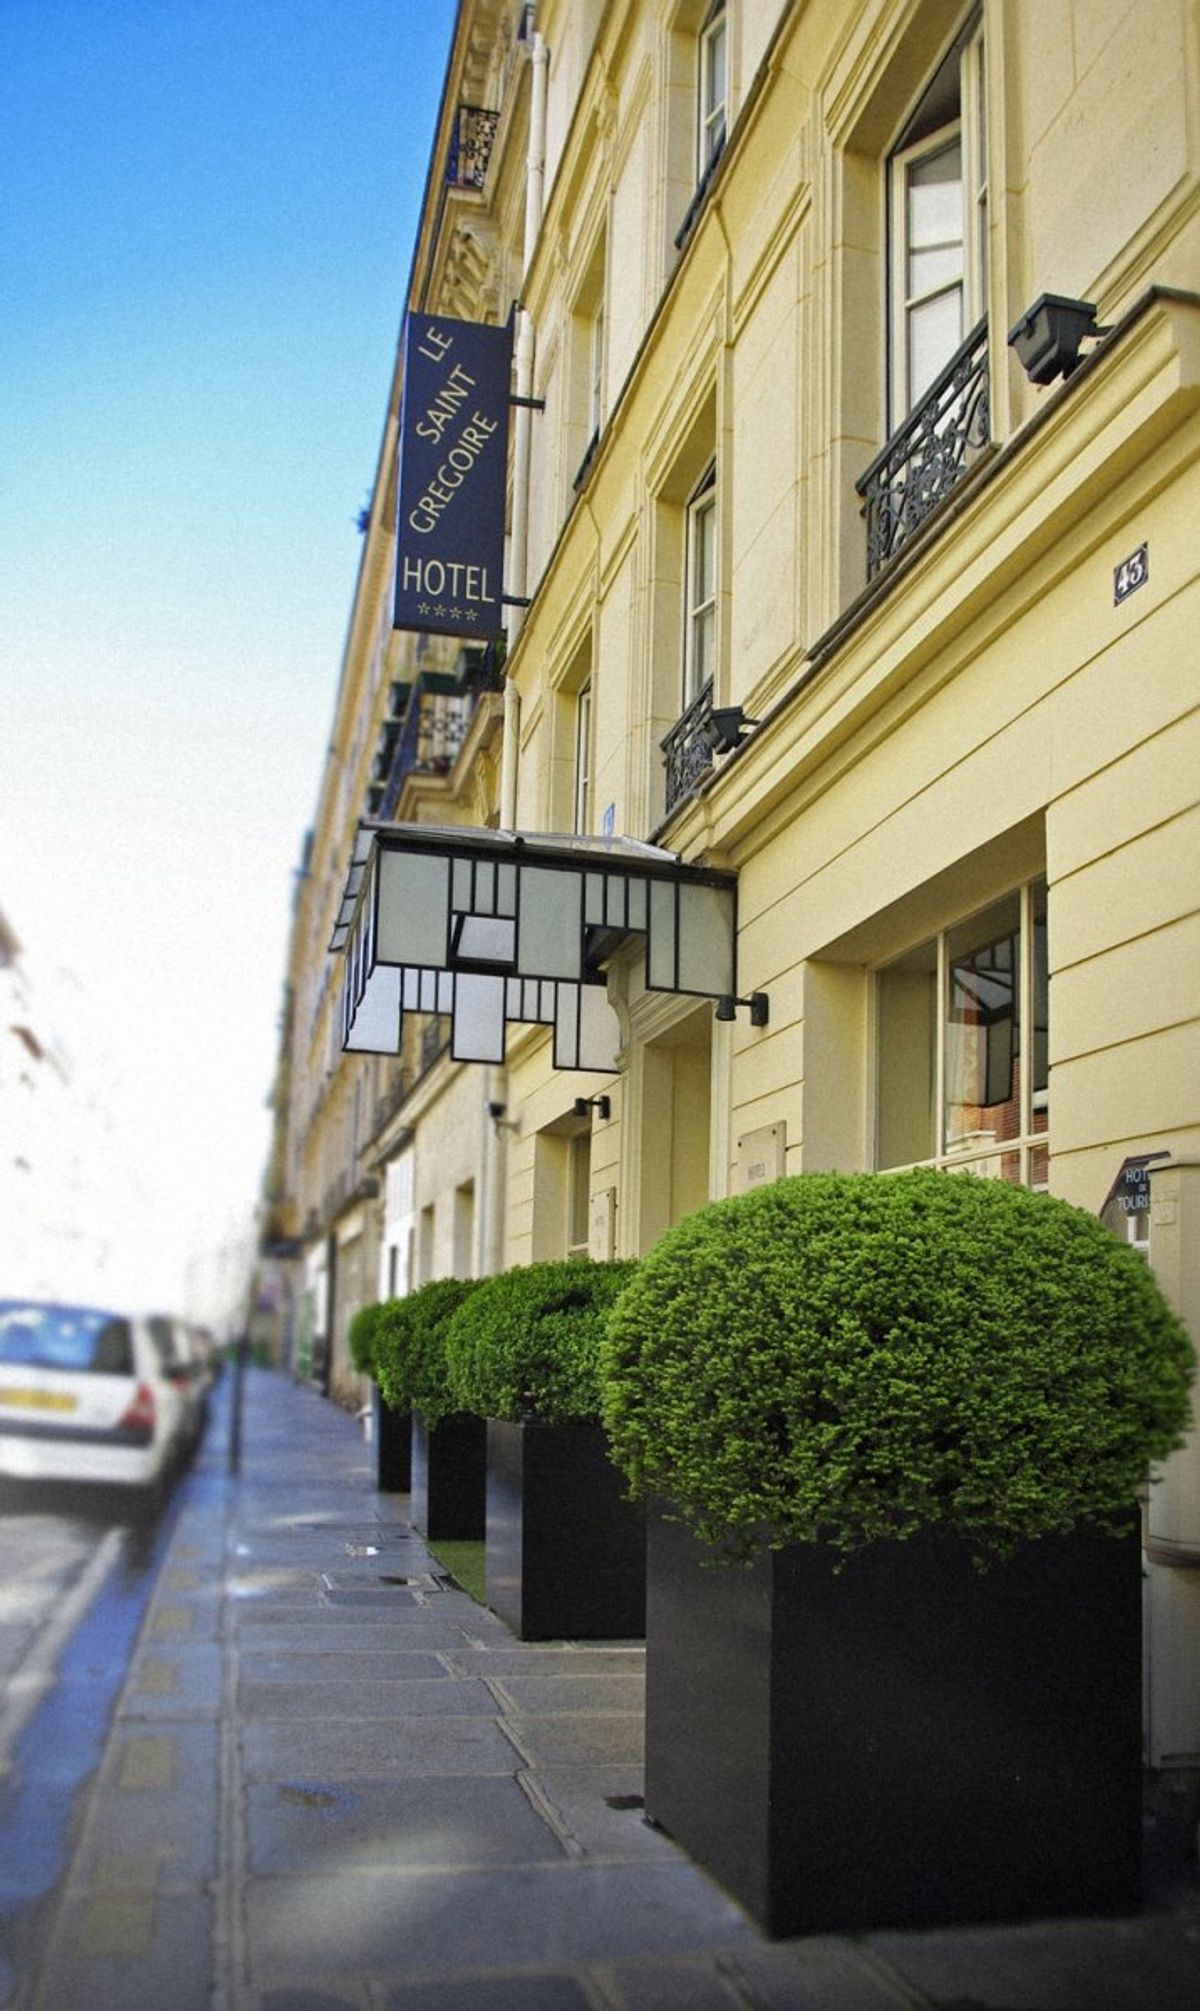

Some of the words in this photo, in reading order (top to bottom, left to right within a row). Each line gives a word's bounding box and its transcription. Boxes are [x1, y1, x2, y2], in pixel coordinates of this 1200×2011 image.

[418, 326, 453, 362] LE
[416, 364, 476, 444] SAINT
[409, 411, 498, 533] GREGOIRE
[403, 556, 495, 602] HOTEL
[1118, 552, 1143, 595] 43
